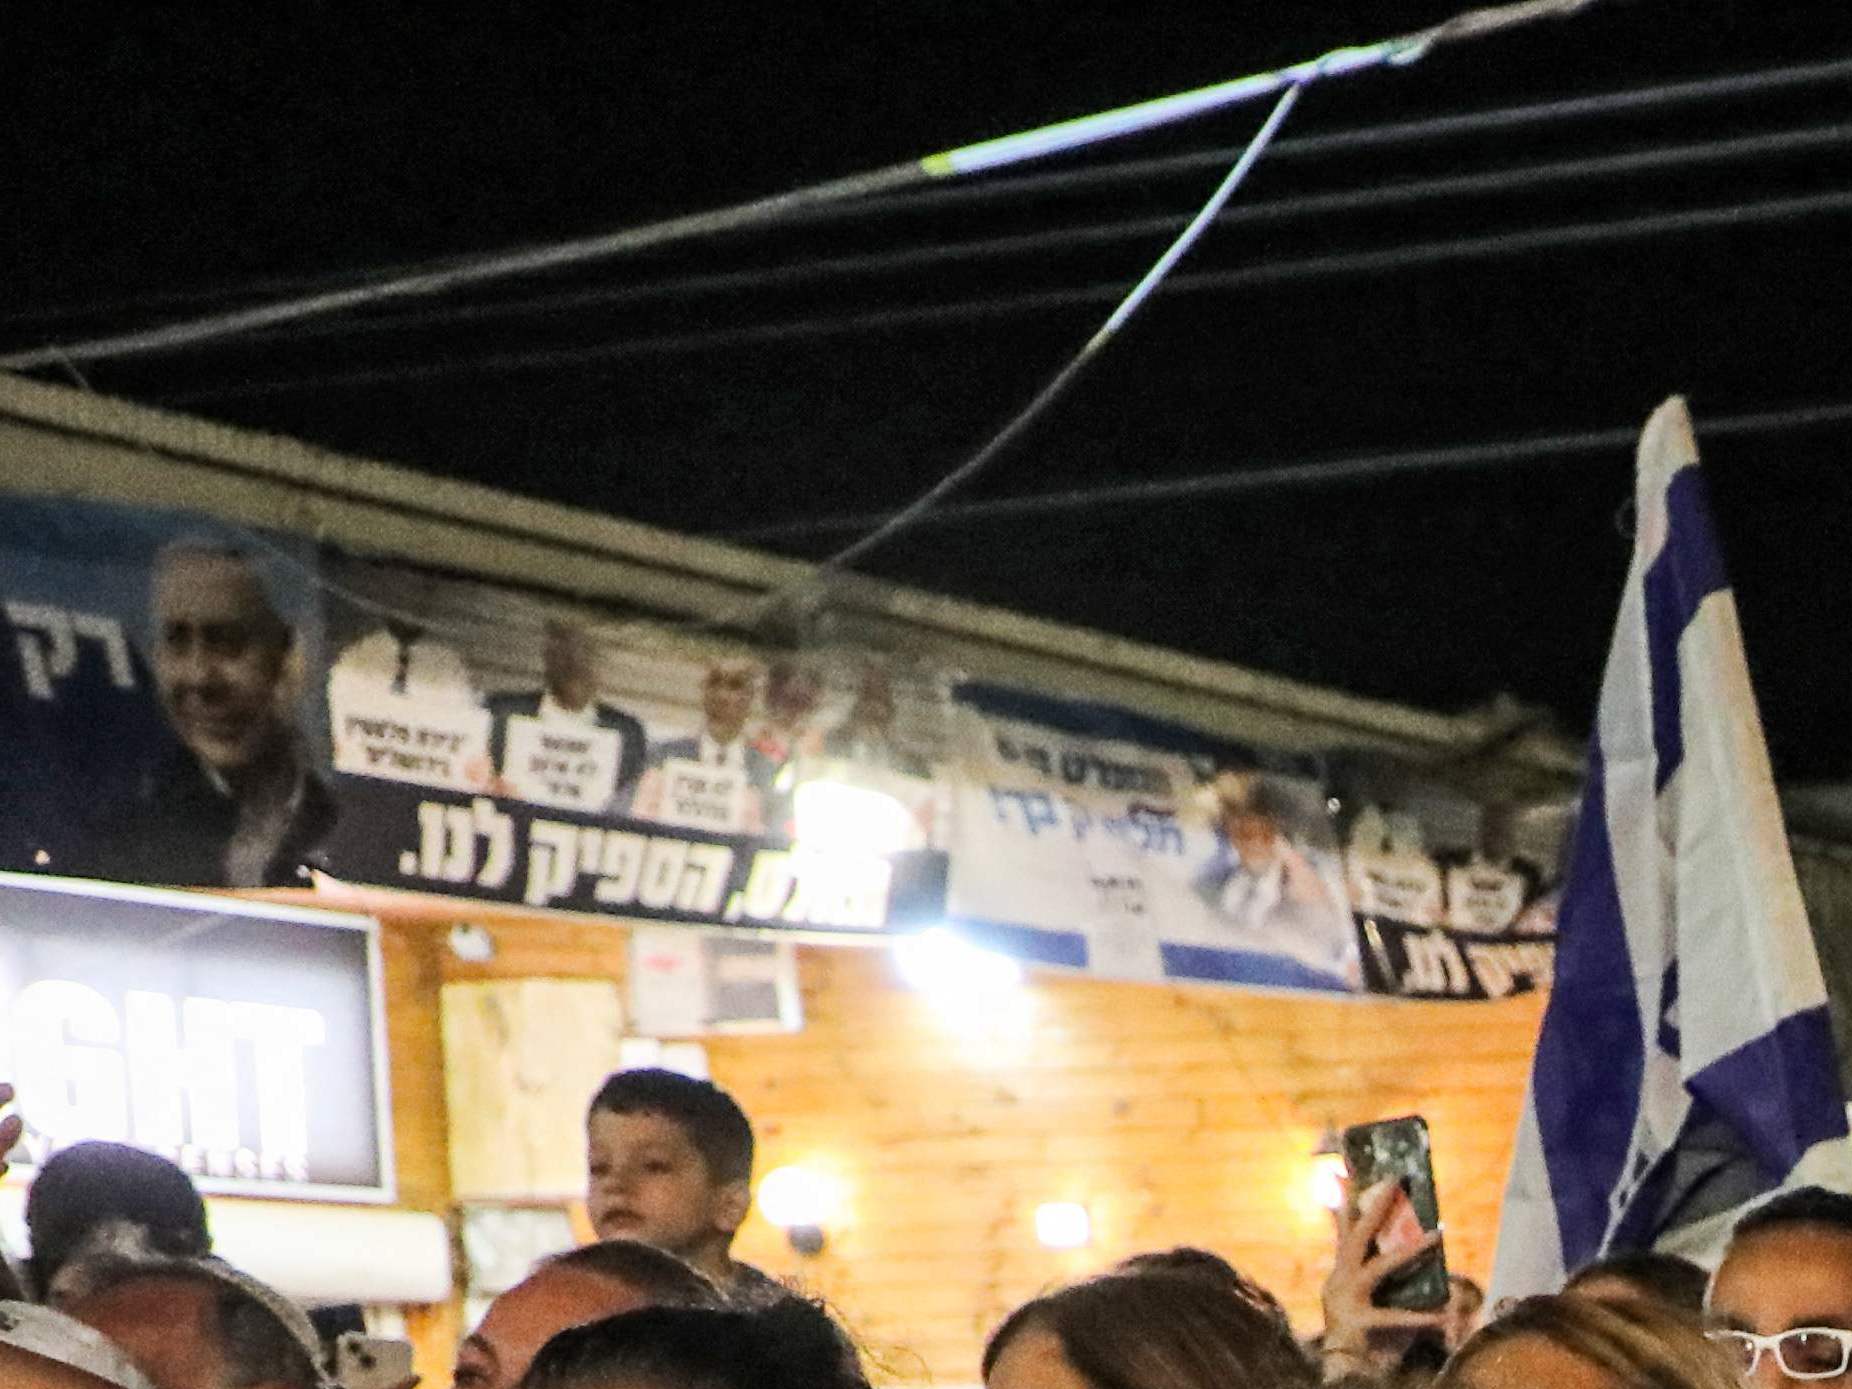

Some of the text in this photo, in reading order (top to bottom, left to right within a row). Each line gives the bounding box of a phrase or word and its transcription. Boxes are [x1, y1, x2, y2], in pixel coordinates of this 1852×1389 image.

[4, 601, 135, 699] רק
[400, 797, 514, 888] לנו.
[527, 818, 734, 915] הספיק
